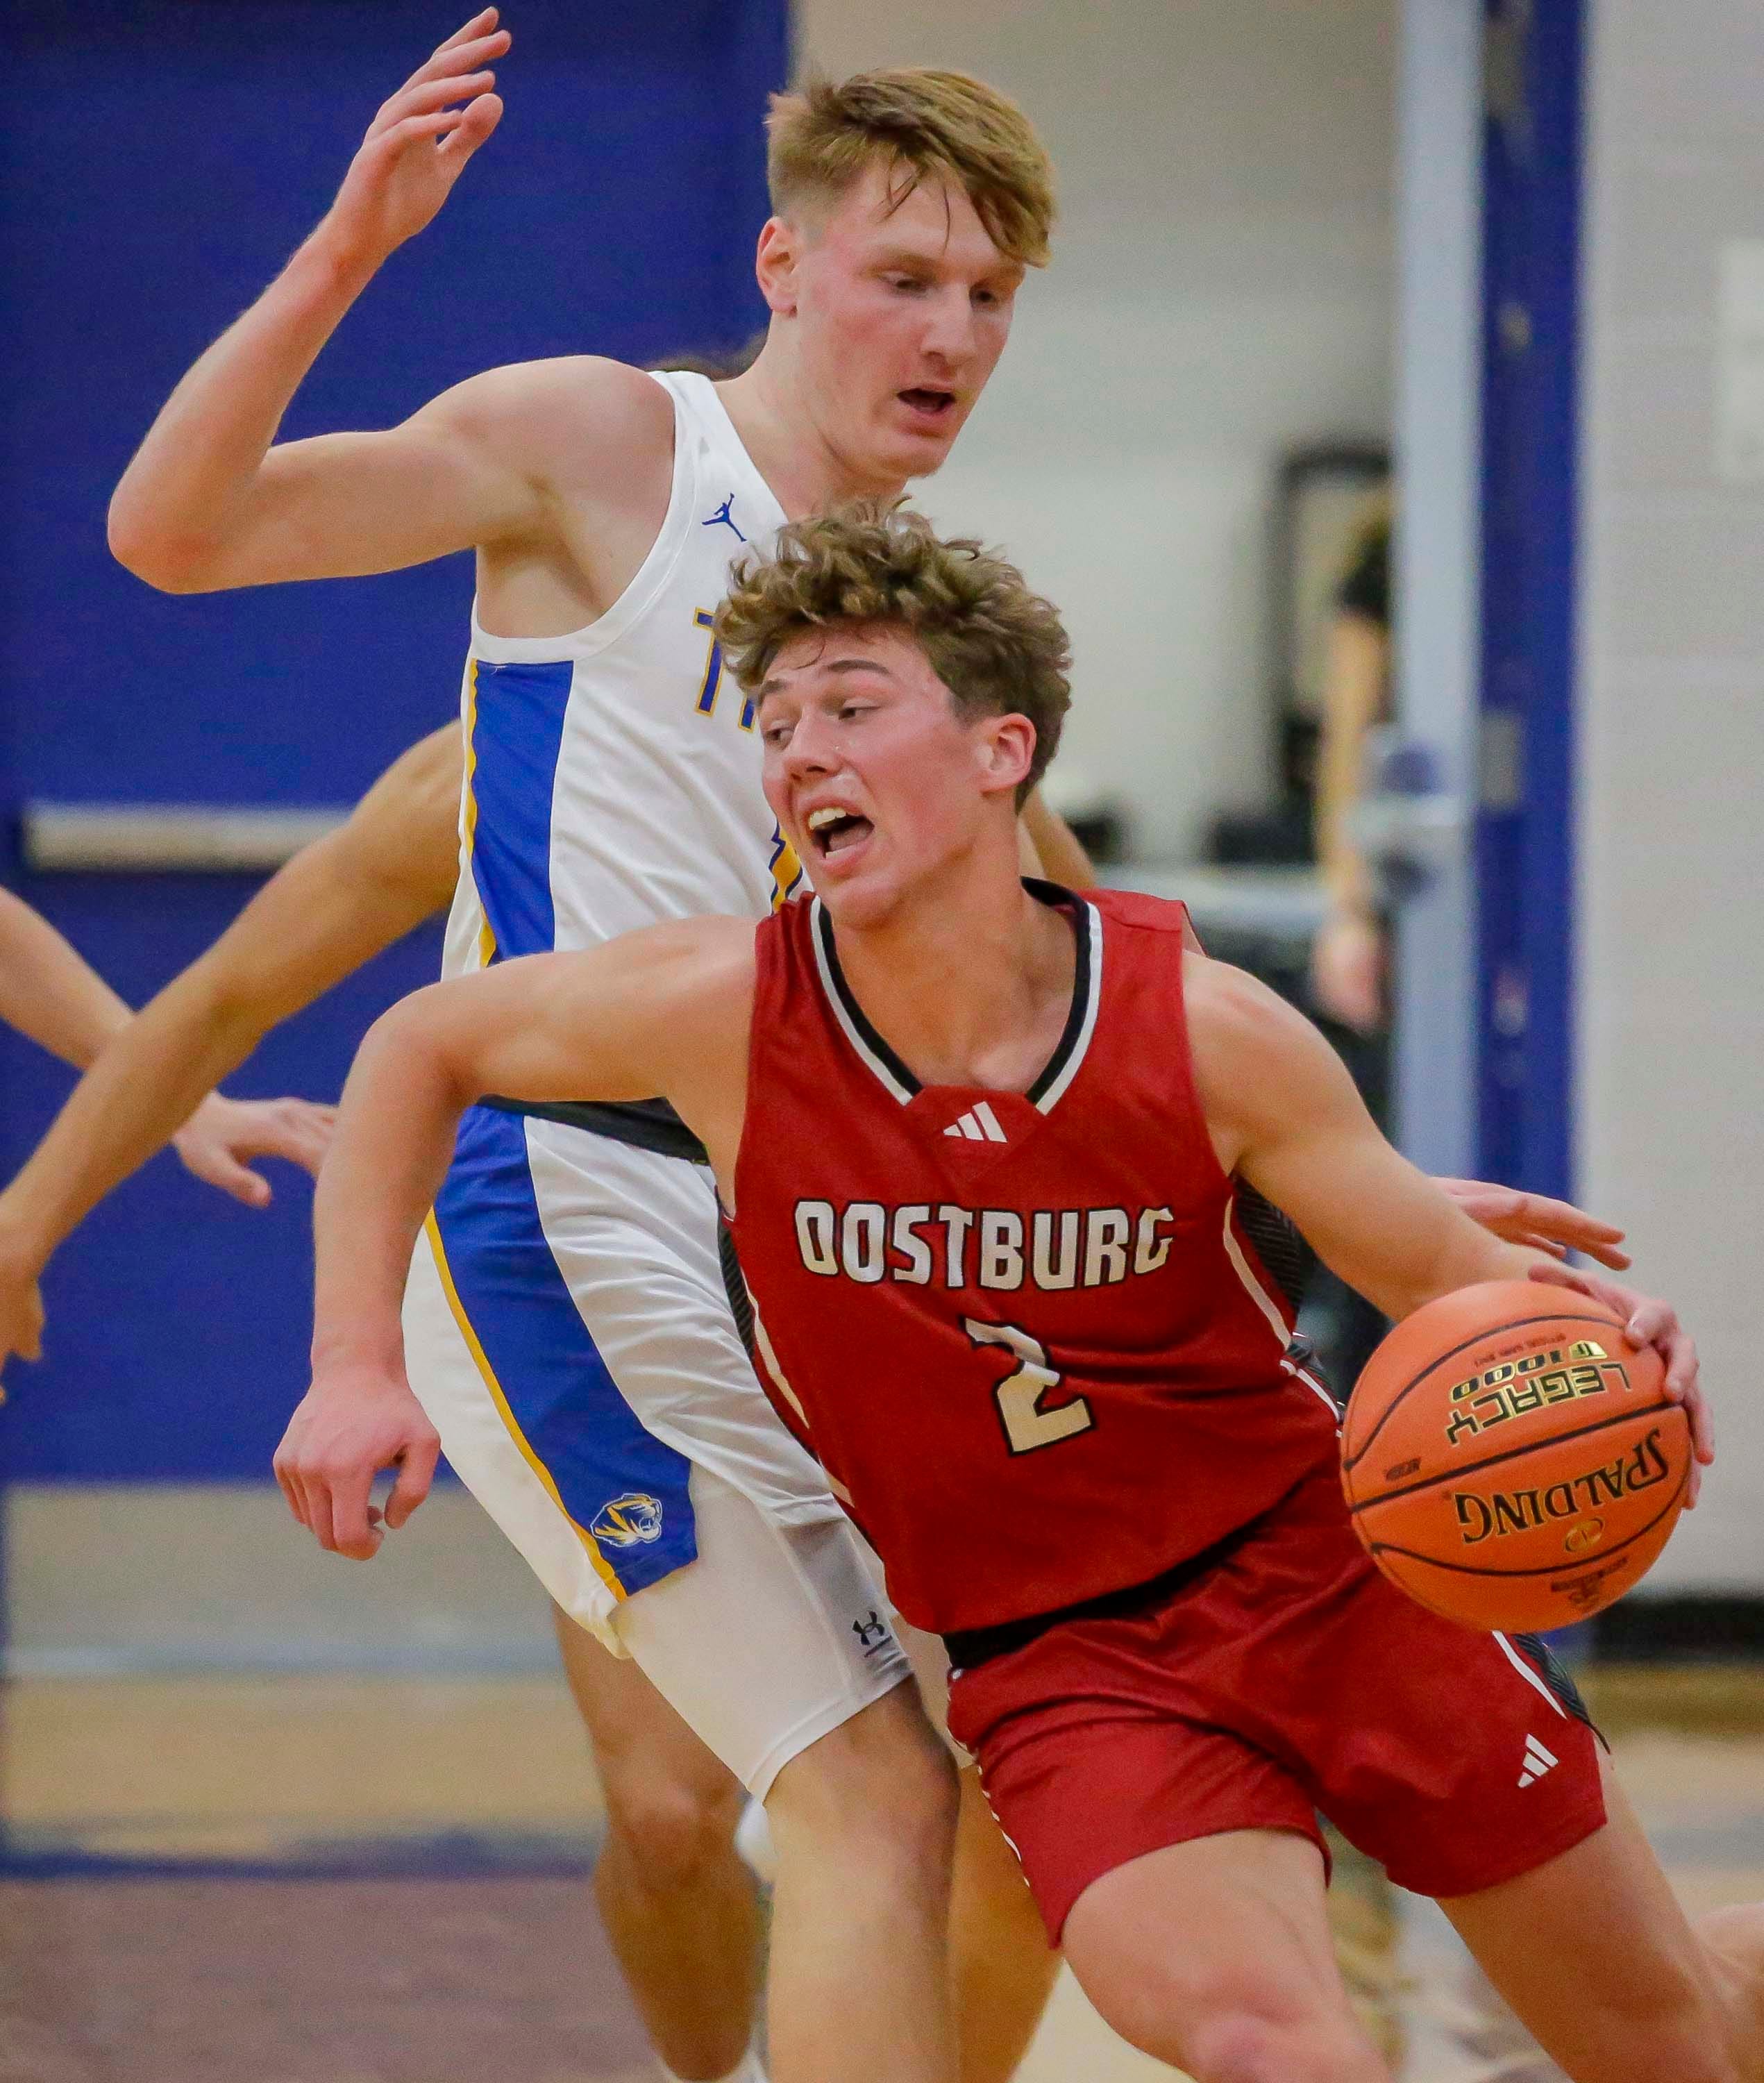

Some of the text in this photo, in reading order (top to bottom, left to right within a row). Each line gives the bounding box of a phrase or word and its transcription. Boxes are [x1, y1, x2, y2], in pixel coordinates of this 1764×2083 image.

[793, 1198, 1174, 1291] OOSTBURG
[961, 1316, 1095, 1455] 2
[1445, 1364, 1631, 1446] LEGACY
[1454, 1427, 1668, 1544] SPALDING
